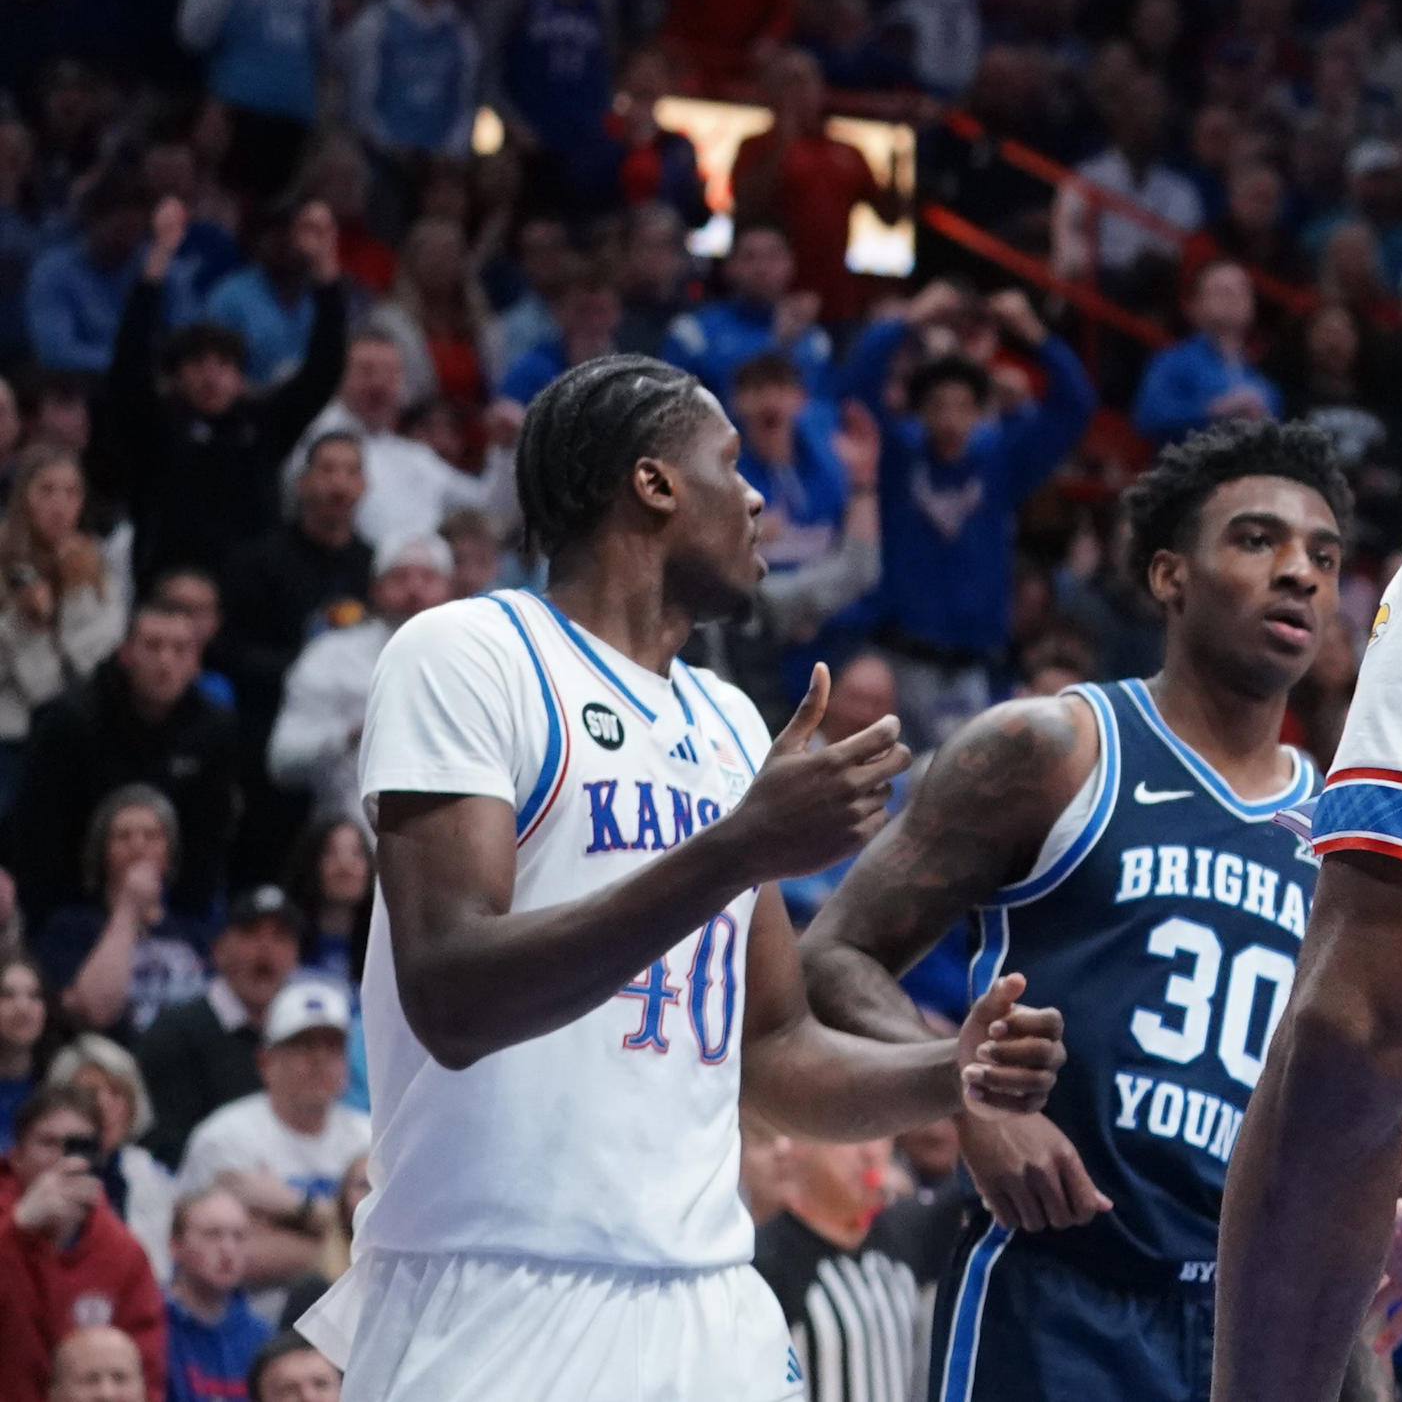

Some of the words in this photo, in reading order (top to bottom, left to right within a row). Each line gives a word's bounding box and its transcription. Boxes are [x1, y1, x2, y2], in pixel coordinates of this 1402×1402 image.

[585, 707, 620, 743] SW
[582, 779, 721, 854] KANS
[1115, 844, 1315, 941] BRIGHA
[616, 909, 738, 1066] 40
[1130, 915, 1297, 1090] 30
[1114, 1070, 1247, 1164] YOUN
[1179, 1260, 1217, 1283] BY
